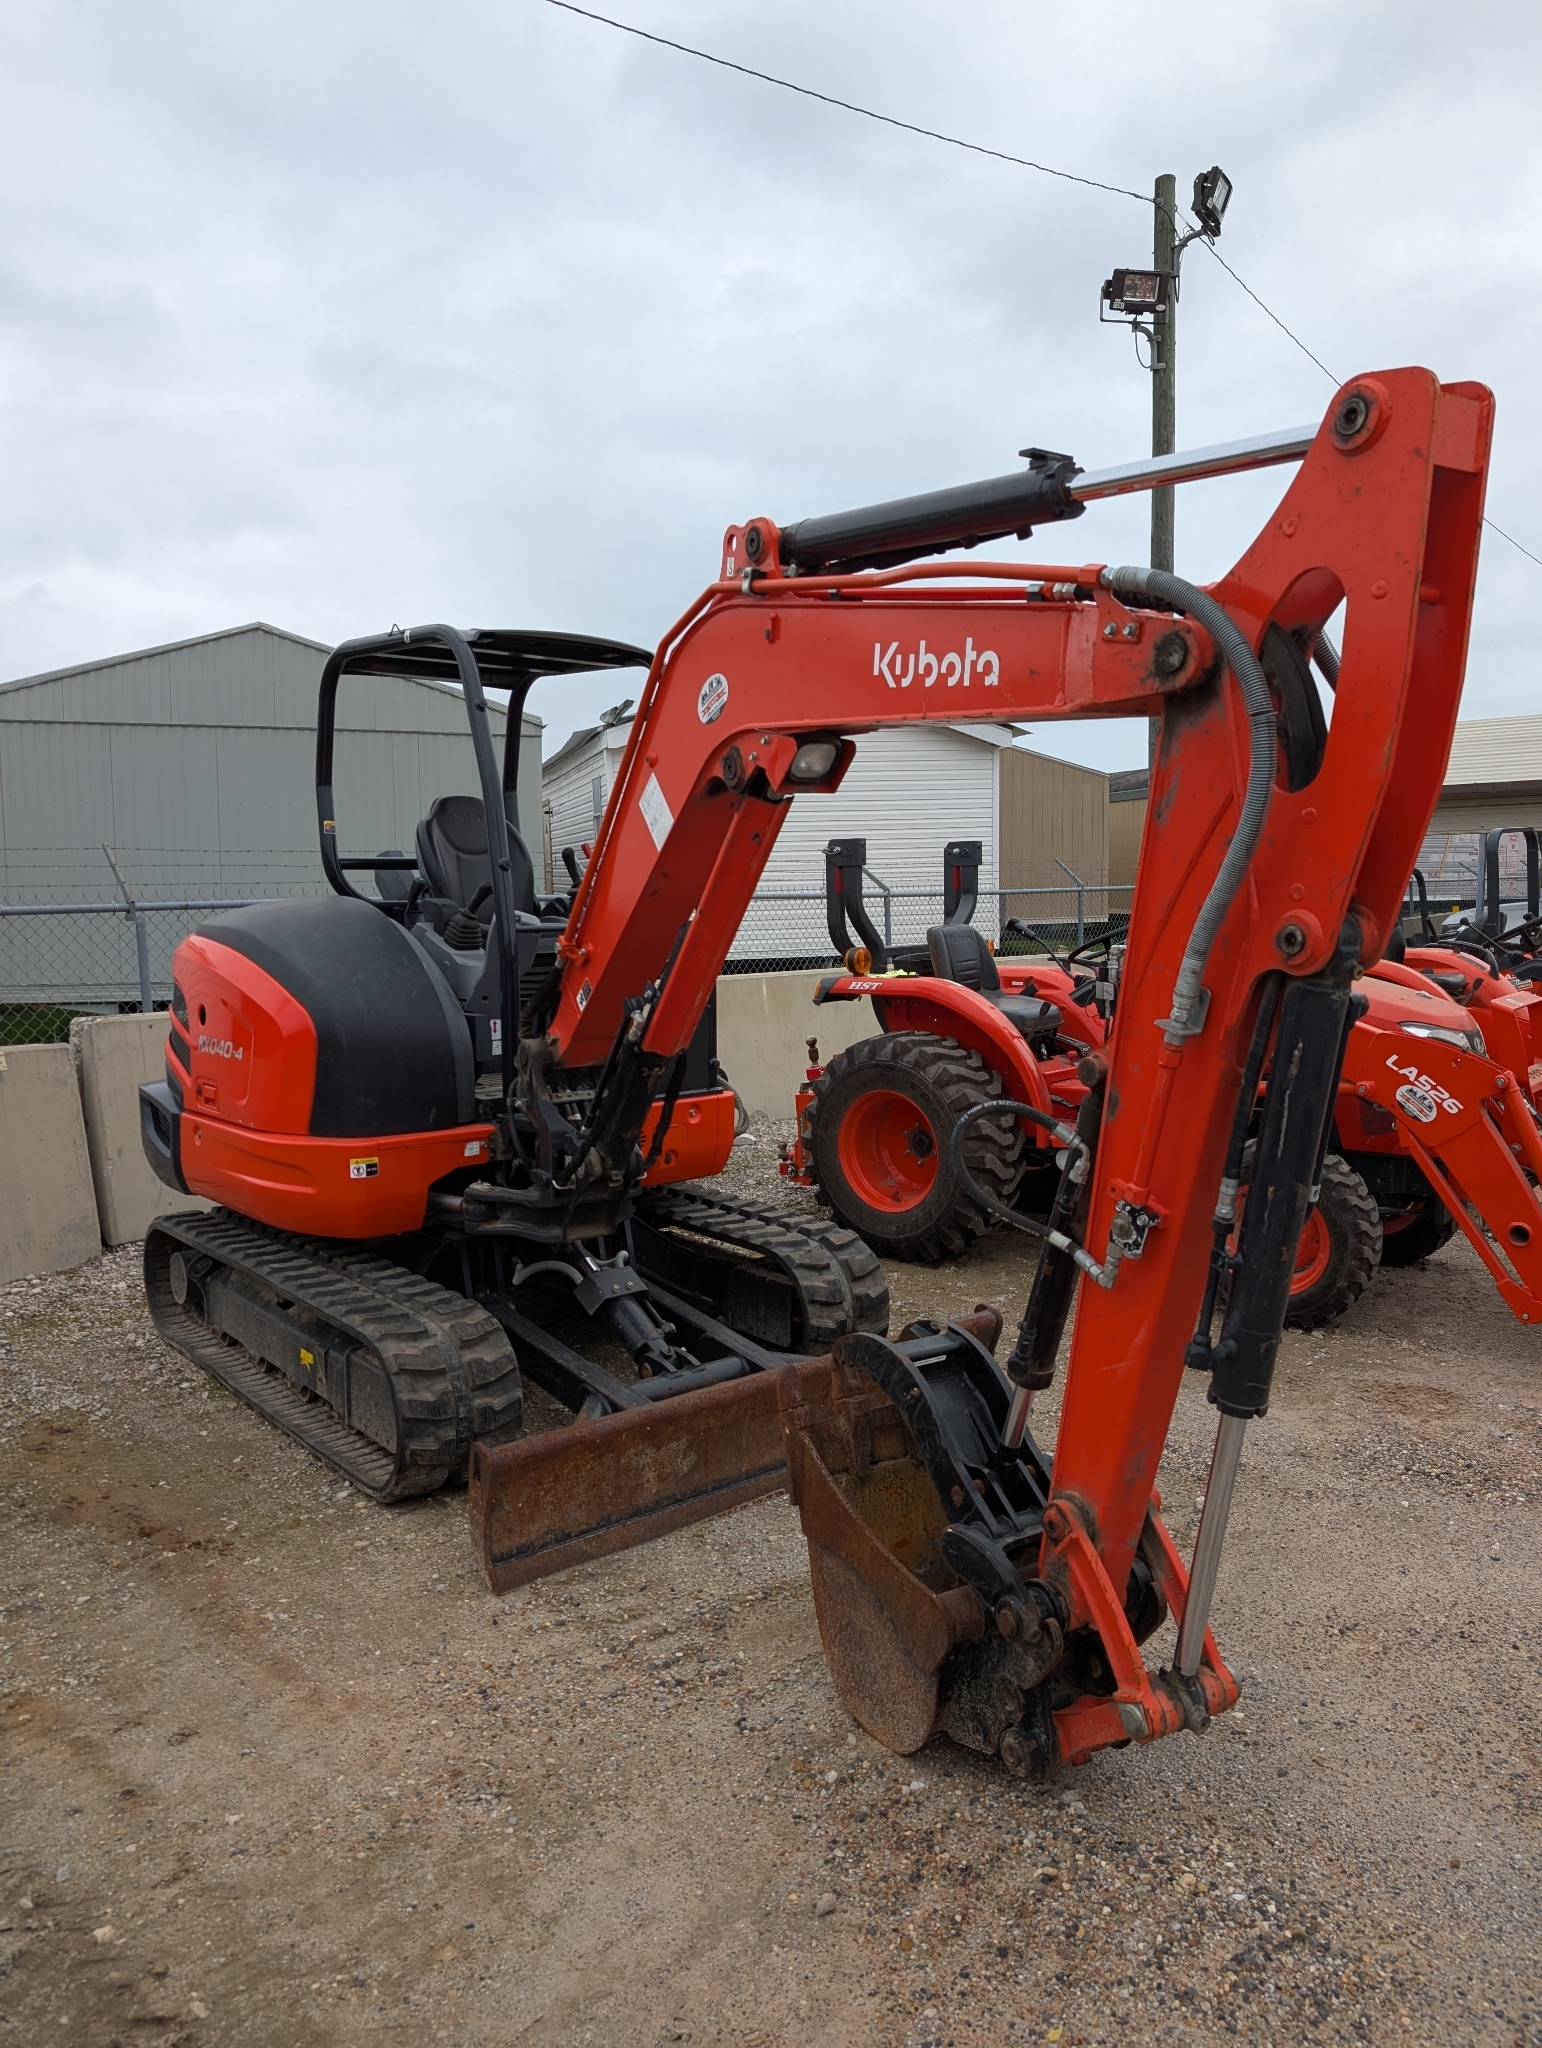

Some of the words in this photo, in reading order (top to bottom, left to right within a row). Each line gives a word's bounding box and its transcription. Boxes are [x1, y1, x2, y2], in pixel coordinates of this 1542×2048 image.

[873, 637, 1000, 689] Kubota
[847, 981, 883, 991] HST
[1385, 1053, 1465, 1114] LA526
